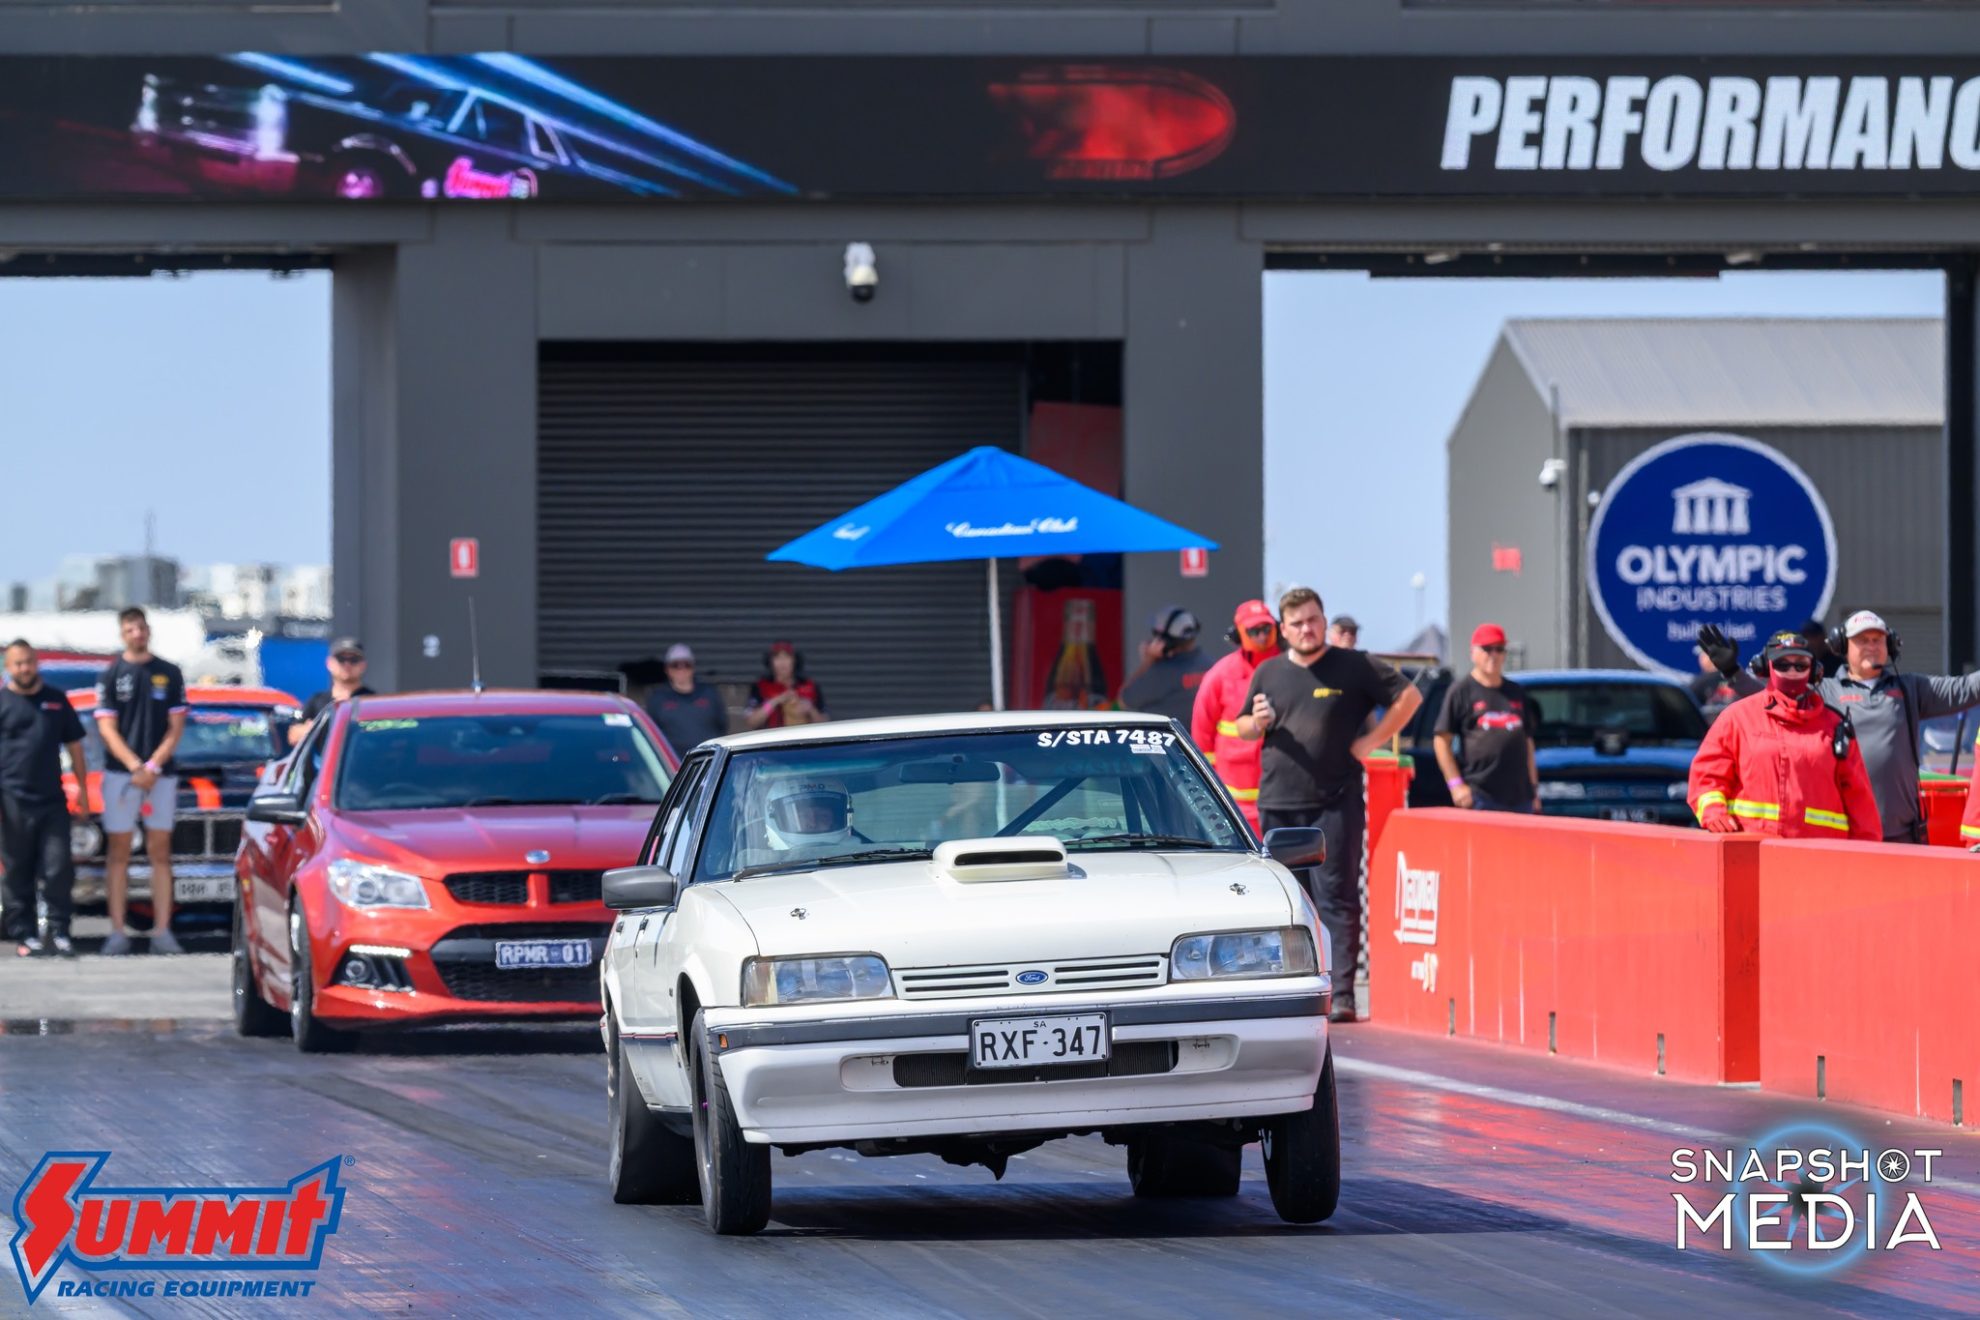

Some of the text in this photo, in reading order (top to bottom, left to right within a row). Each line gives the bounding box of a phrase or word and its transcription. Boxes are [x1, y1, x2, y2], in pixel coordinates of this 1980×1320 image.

[1616, 544, 1808, 585] OLYMPIC
[1637, 586, 1788, 612] INDUSTRIES
[1037, 729, 1176, 748] S/STA 7487
[501, 944, 584, 964] RPMR 01
[1033, 1020, 1047, 1028] SA
